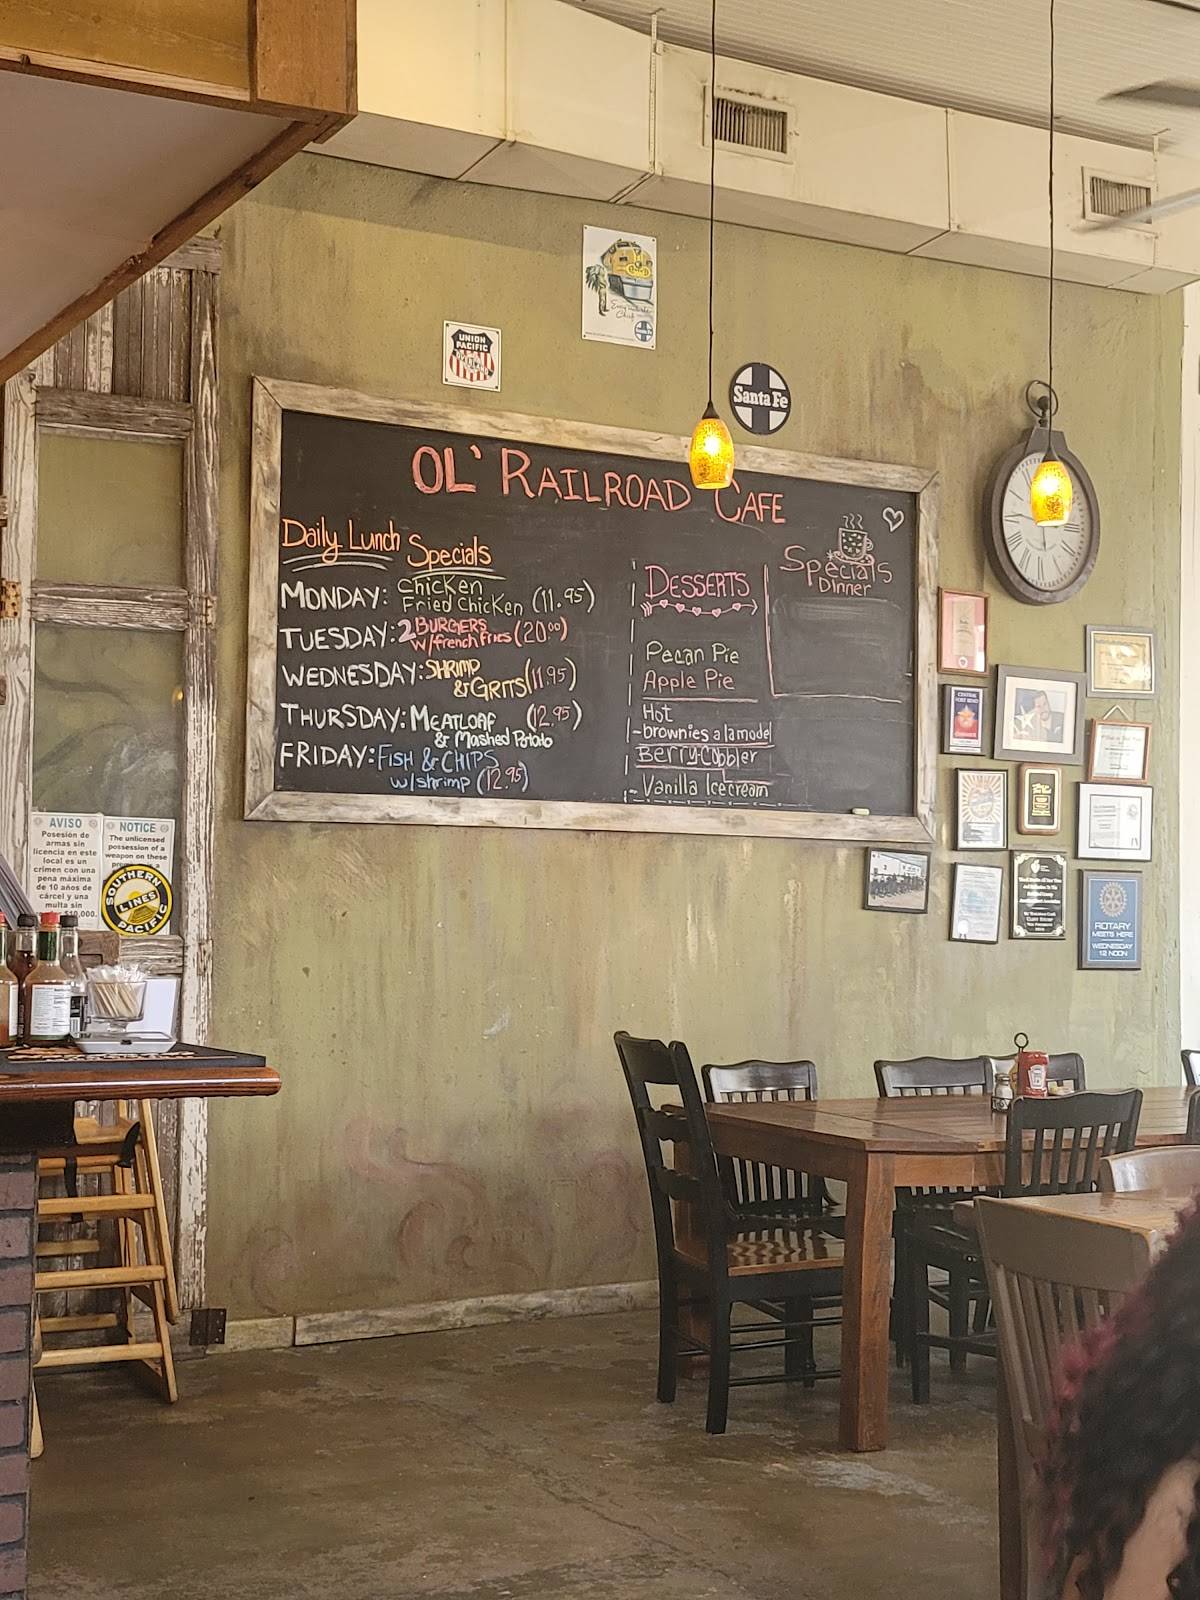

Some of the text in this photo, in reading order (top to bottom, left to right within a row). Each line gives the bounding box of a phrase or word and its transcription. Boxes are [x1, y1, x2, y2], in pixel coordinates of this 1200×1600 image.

[456, 342, 488, 351] PACIFIC
[458, 334, 486, 343] UNION
[733, 385, 789, 409] Santa Fe
[412, 445, 786, 523] OL' RAILROAD CAFE
[282, 517, 492, 570] Daily Lunch Specials
[779, 545, 892, 586] Specials
[281, 575, 483, 611] MONDAY: Chicken
[645, 565, 750, 599] DESSERTS
[403, 580, 595, 616] Fried Chicken (11.95)
[280, 617, 487, 652] TUESDAY: 2 BURGERS
[646, 641, 739, 664] Pecan Pie
[281, 659, 481, 687] WEDNESDAY: SHRIMP
[644, 668, 734, 693] Apple Pie
[281, 703, 407, 730] THURSDAY:
[527, 700, 582, 732] (12.95)
[642, 704, 673, 722] Hot
[434, 728, 553, 748] & Mashed Potato
[713, 731, 720, 740] a
[280, 742, 376, 768] FRIDAY:
[422, 747, 439, 772] &
[442, 749, 499, 773] CHIPS
[390, 761, 529, 795] w/shrimp (12.95)
[643, 773, 698, 796] Vanilla
[50, 818, 82, 828] AVISO
[120, 822, 156, 832] NOTICE
[106, 870, 161, 905] SOUTHERN
[120, 891, 156, 912] LINES
[118, 904, 167, 933] PACIFIC
[1094, 922, 1132, 930] ROTARY
